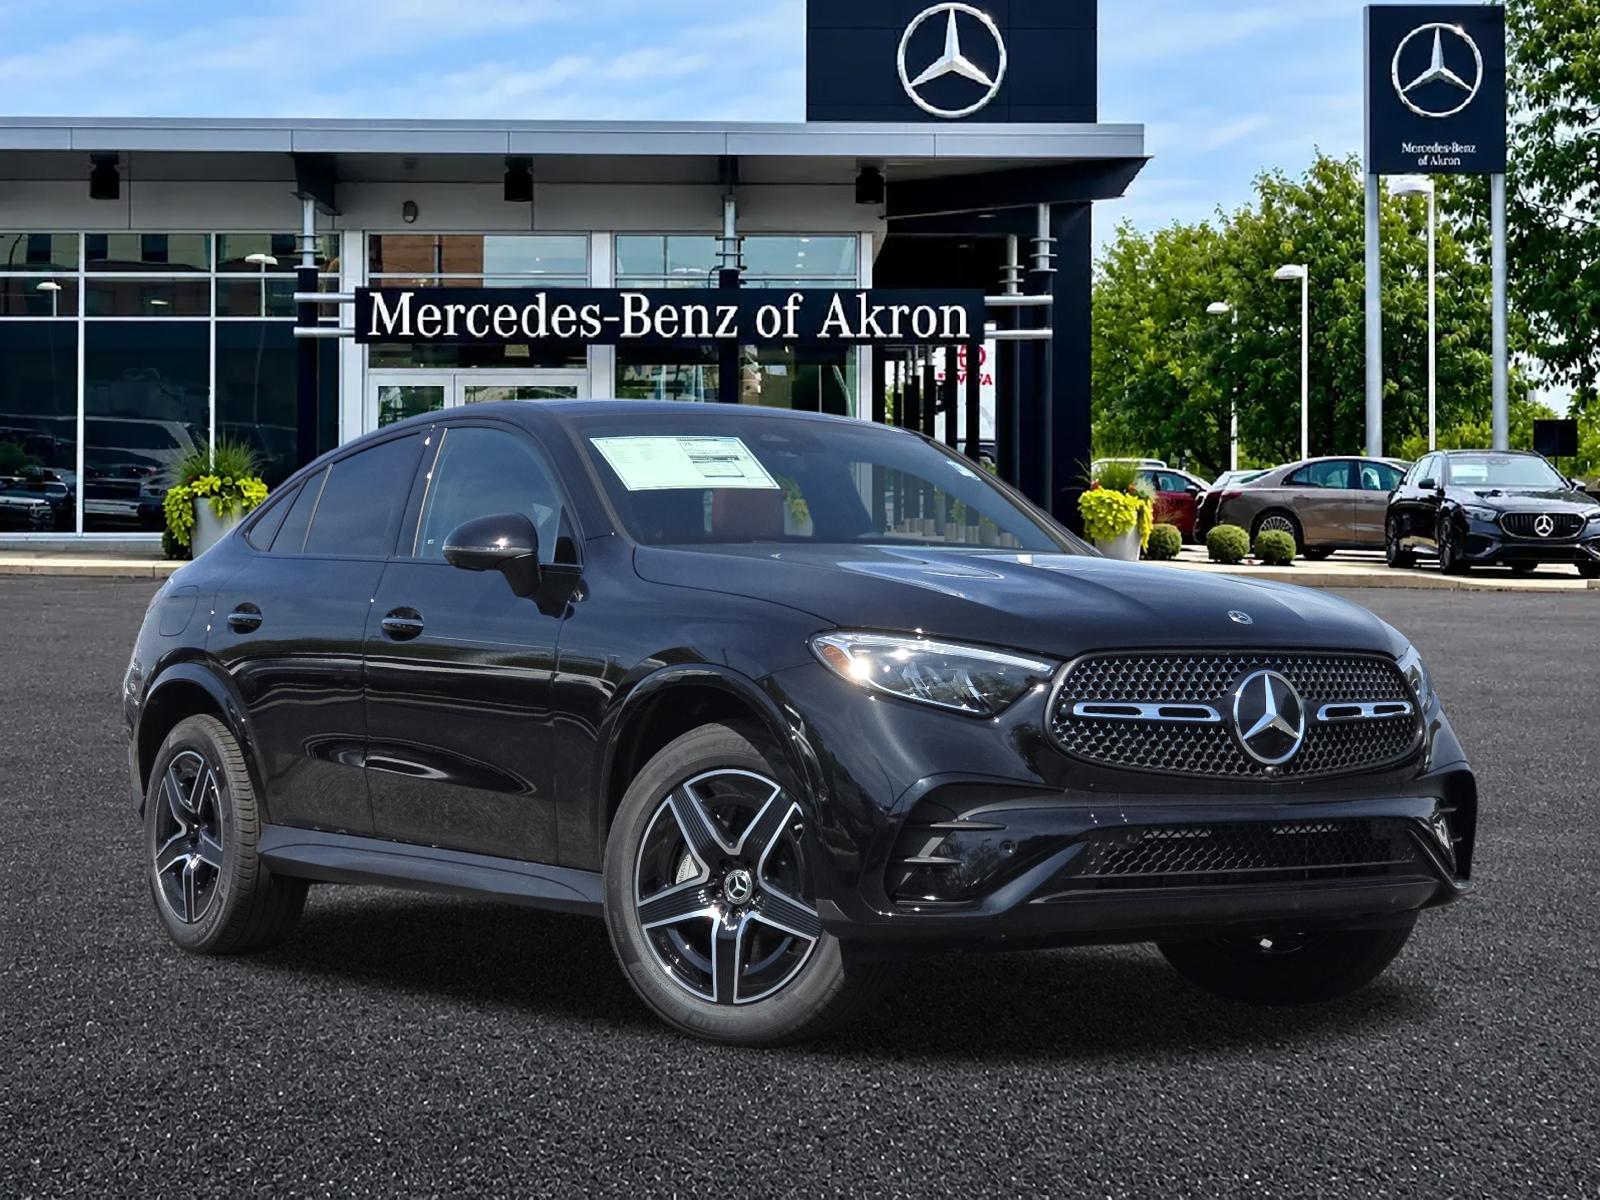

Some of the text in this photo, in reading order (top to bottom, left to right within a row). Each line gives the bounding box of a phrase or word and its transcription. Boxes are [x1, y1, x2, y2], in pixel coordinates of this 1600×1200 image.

[1401, 141, 1477, 154] Mercedes-Benz
[1417, 154, 1461, 166] of Akron
[367, 292, 970, 338] Mercedes-Benz of Akron
